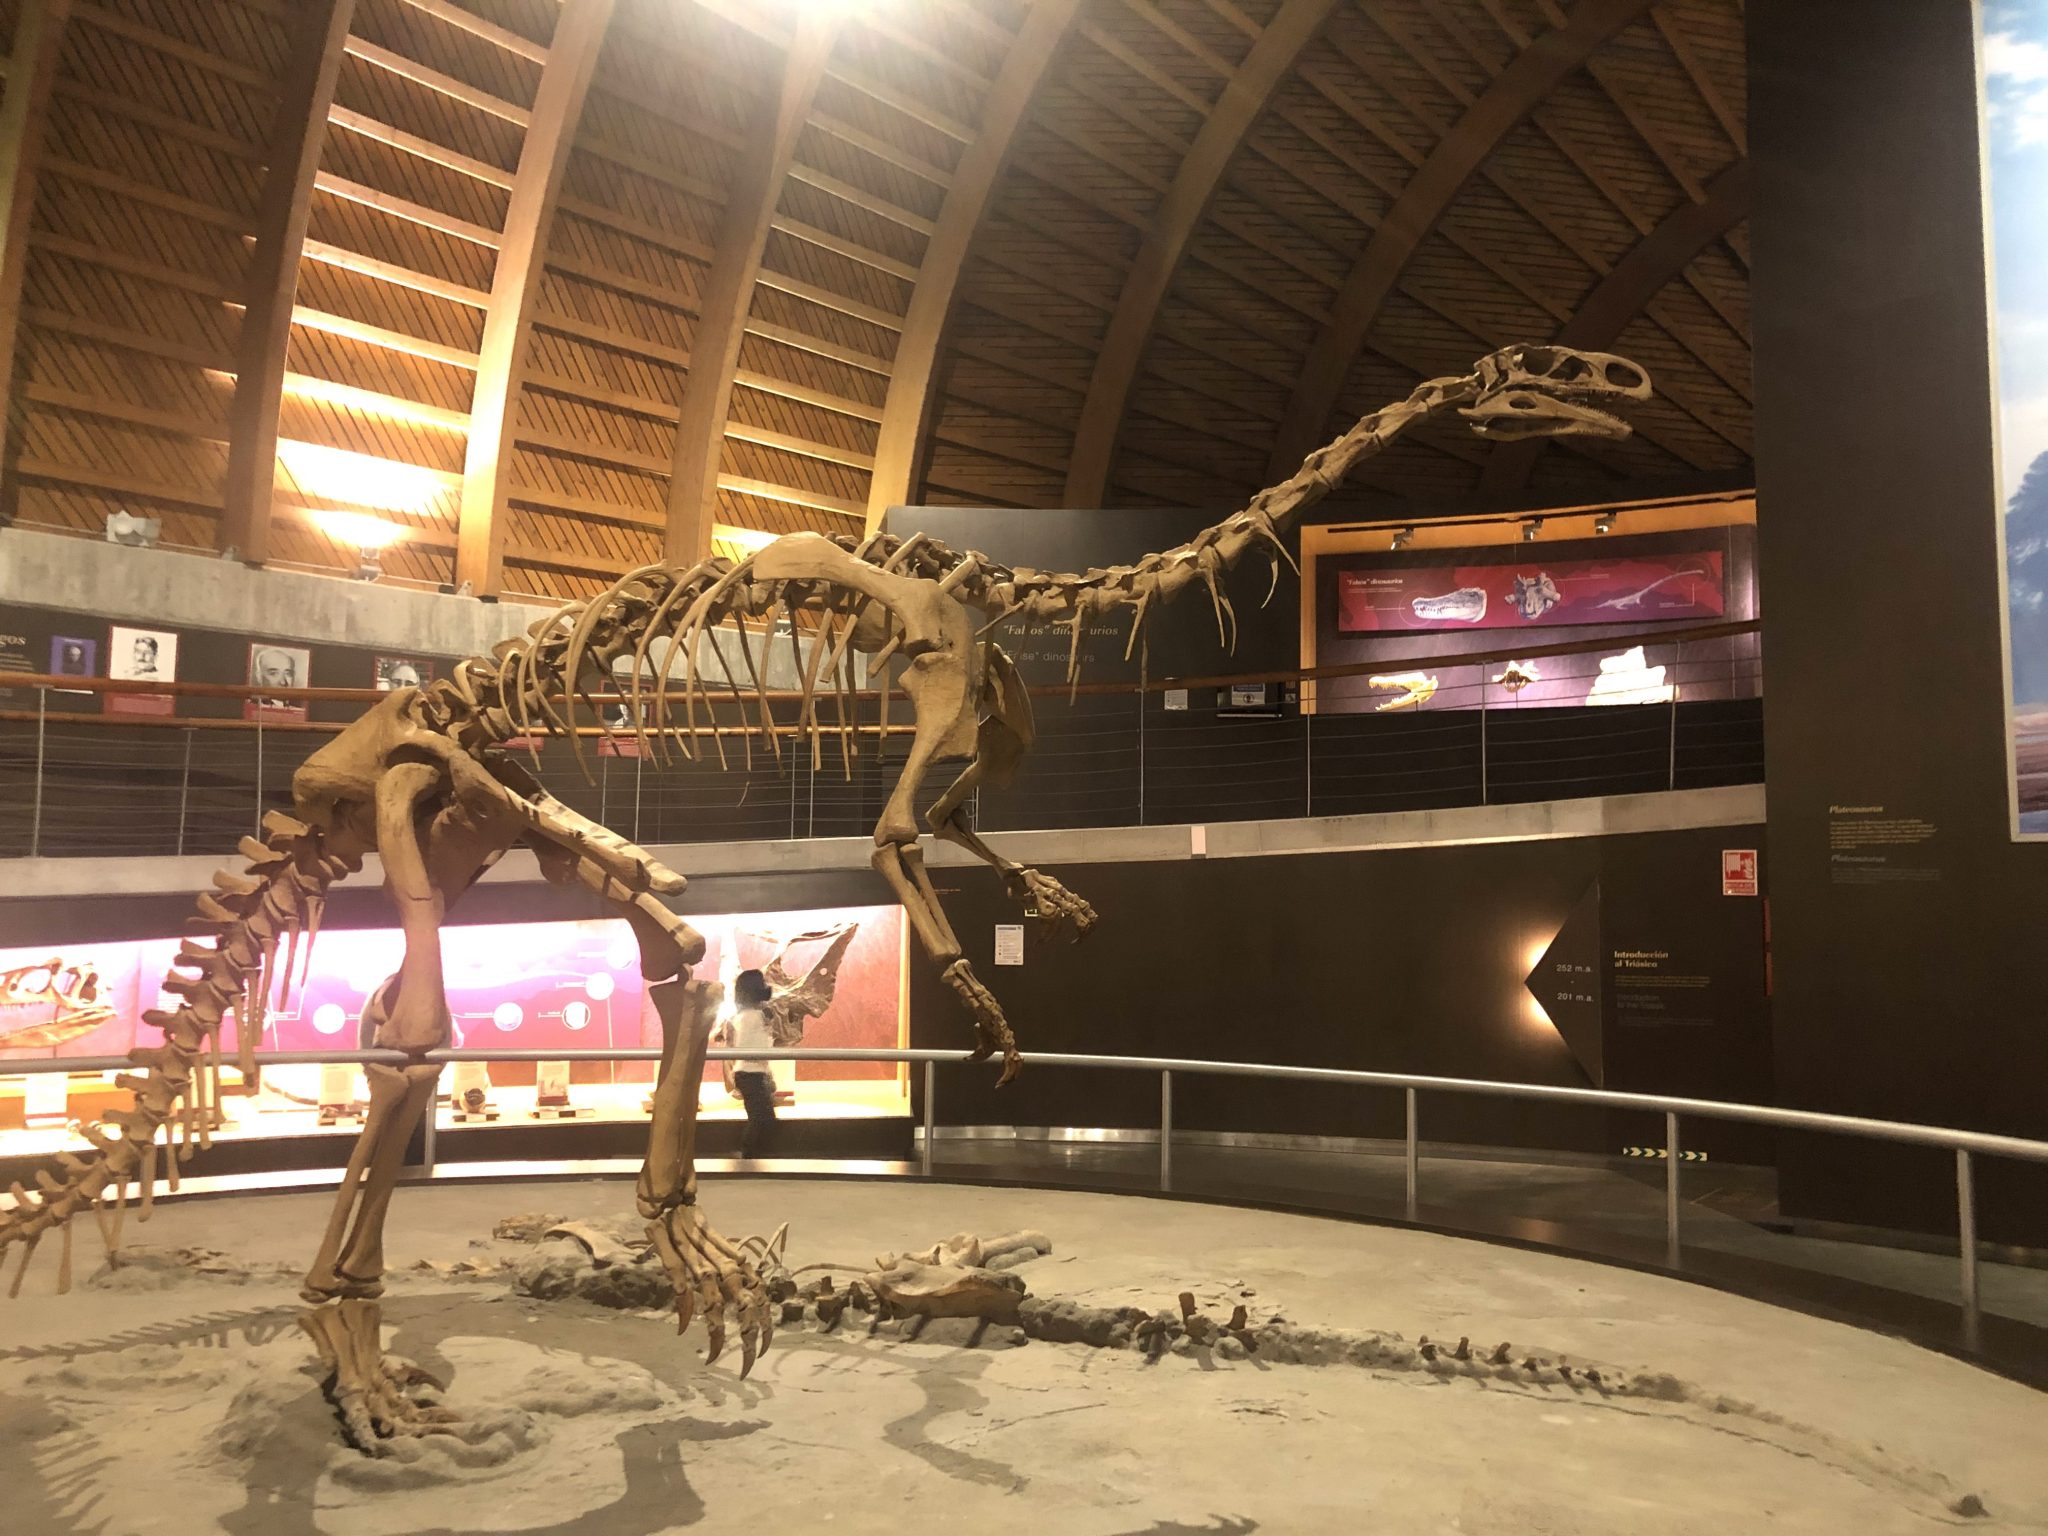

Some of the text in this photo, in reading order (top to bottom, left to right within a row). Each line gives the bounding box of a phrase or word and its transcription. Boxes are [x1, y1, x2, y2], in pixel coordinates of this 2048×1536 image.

[1003, 624, 1118, 635] "Falos" dinurios
[1614, 950, 1669, 959] Introducción
[1556, 964, 1572, 972] 252
[1614, 959, 1658, 968] al Triásico
[1557, 992, 1572, 1001] 201
